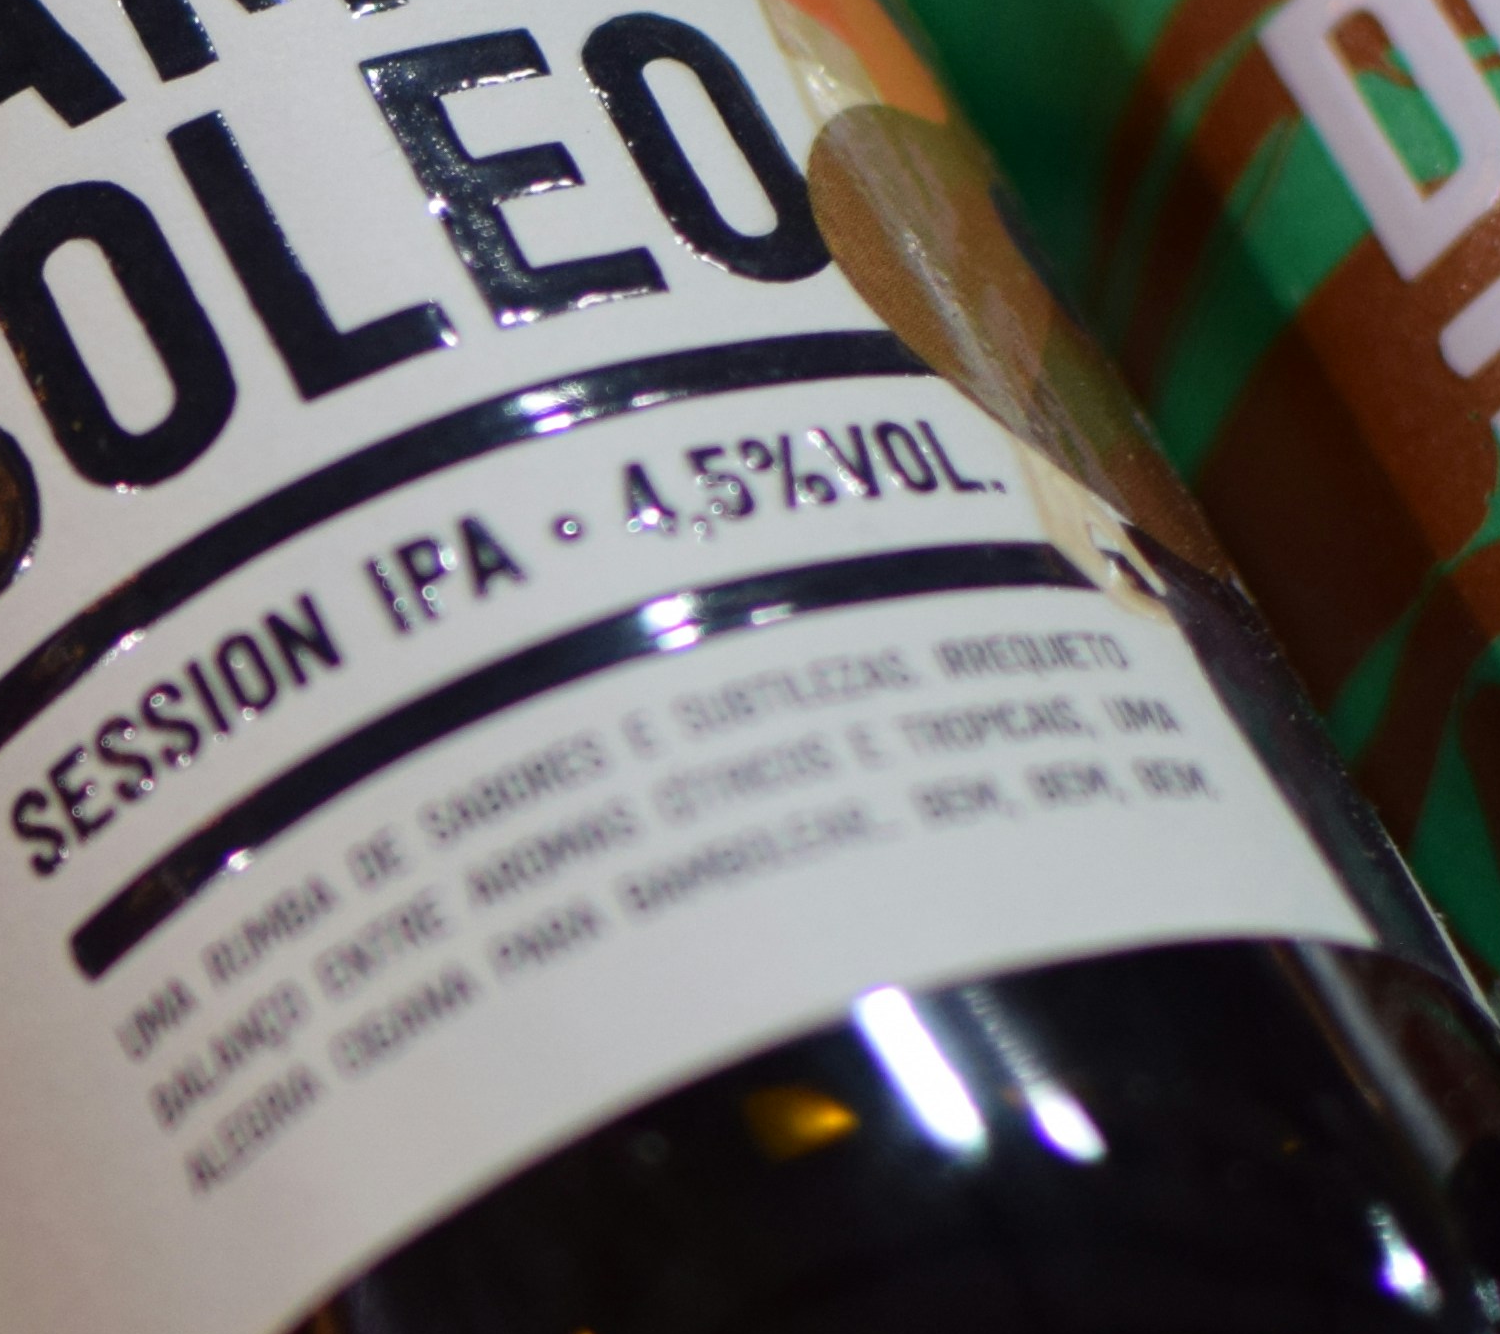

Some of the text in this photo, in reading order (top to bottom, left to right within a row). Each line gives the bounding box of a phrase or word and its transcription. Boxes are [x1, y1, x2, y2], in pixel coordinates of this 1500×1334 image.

[9, 591, 342, 877] SESSION
[364, 513, 527, 633] IPA
[1101, 696, 1184, 737] UMA
